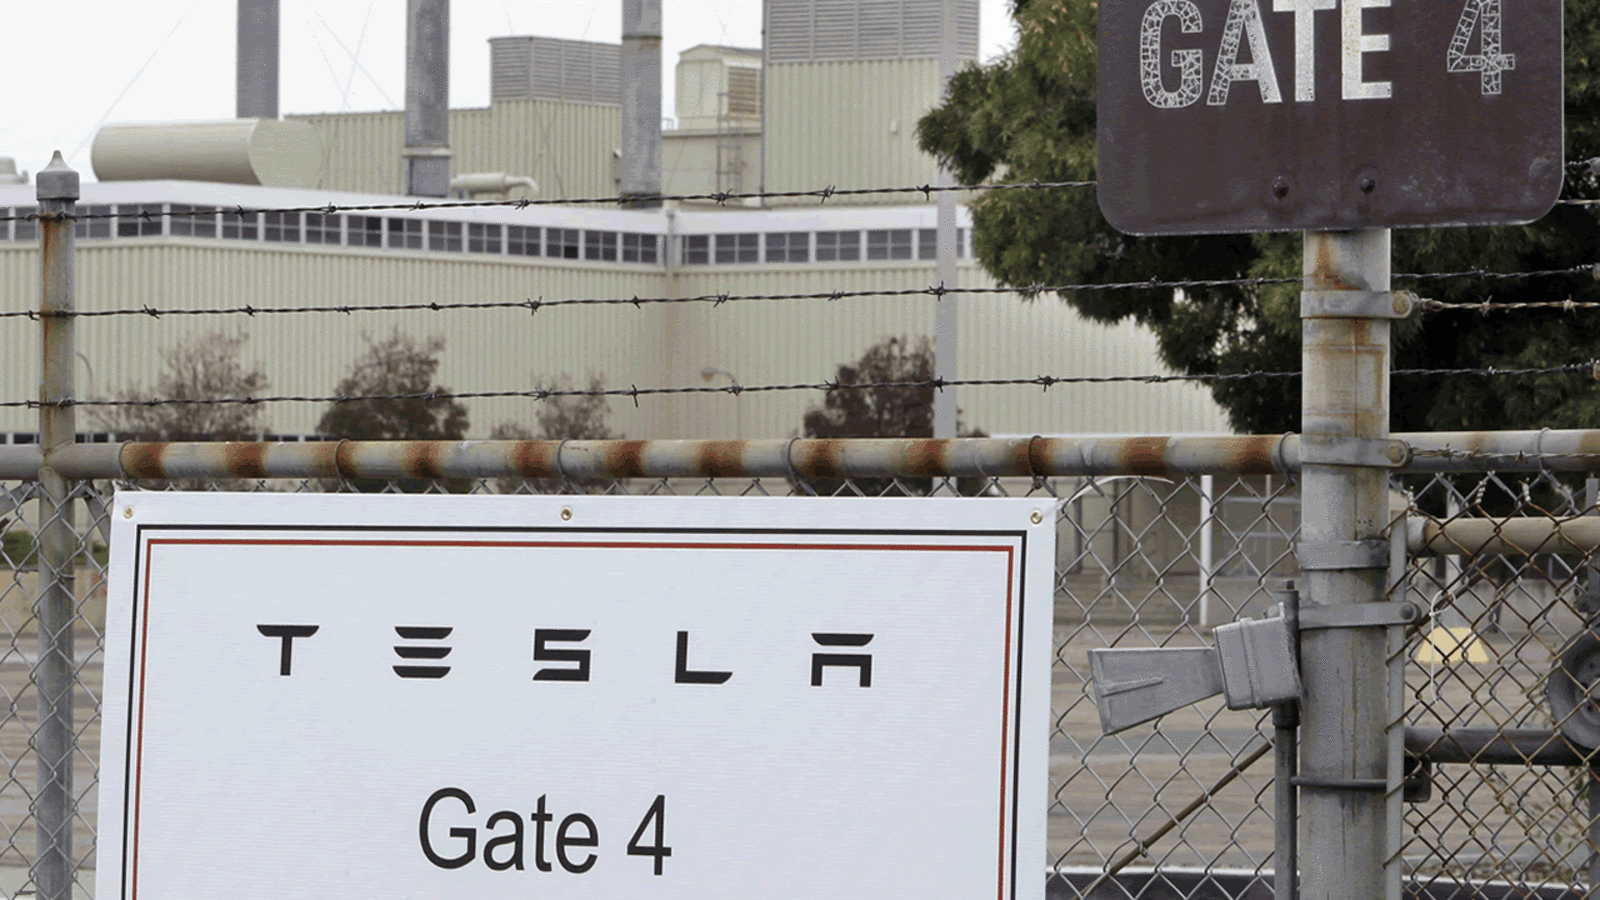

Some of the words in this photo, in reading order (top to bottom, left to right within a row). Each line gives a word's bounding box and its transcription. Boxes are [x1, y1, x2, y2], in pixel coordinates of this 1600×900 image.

[1139, 0, 1393, 108] GATE
[1446, 0, 1516, 95] 4
[256, 624, 875, 688] TESLA
[418, 787, 599, 875] Gate
[626, 794, 673, 876] 4
